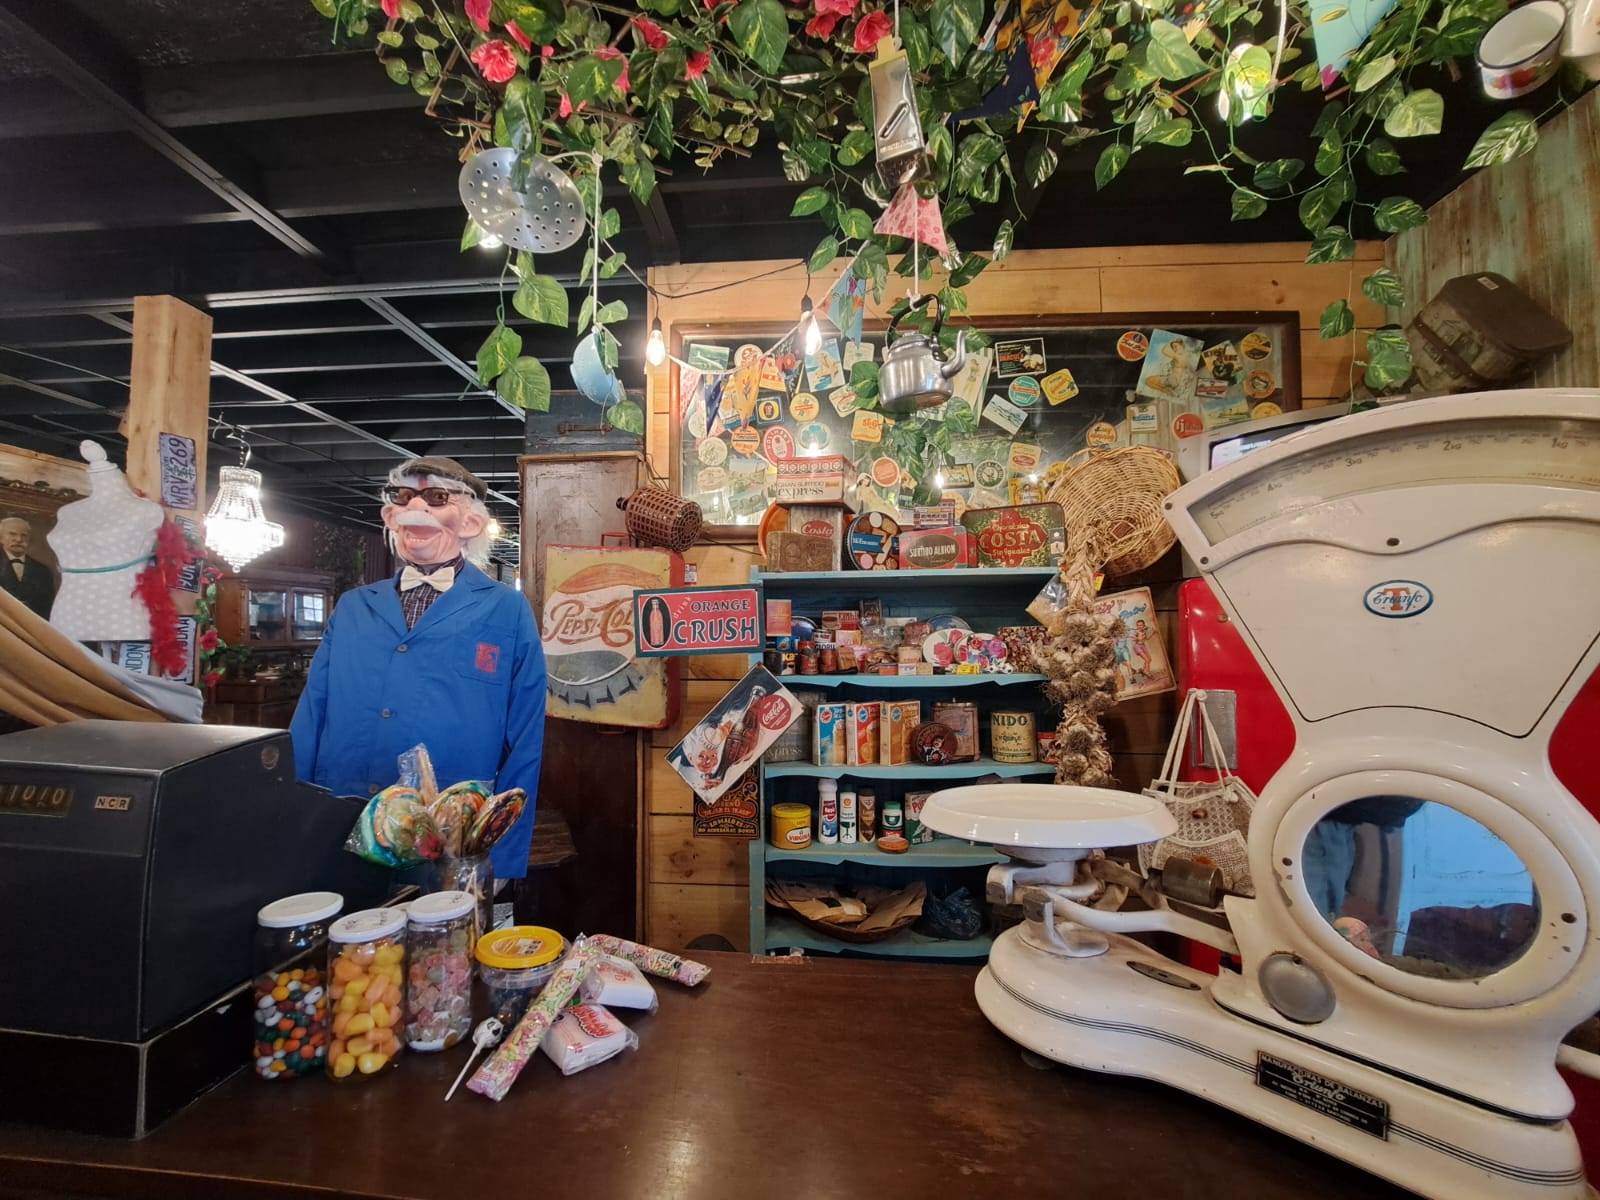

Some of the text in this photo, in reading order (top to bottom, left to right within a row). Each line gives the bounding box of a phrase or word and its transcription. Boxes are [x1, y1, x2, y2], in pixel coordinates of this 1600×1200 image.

[169, 437, 188, 467] 269
[169, 475, 188, 508] WRV
[777, 487, 824, 499] express
[801, 522, 834, 535] Costa
[979, 529, 1041, 549] COSTA
[690, 598, 751, 613] ORANGE
[673, 616, 757, 645] CRUSH
[761, 697, 786, 725] Coca-Cola
[992, 713, 1028, 727] NIDO
[97, 797, 128, 809] NCR
